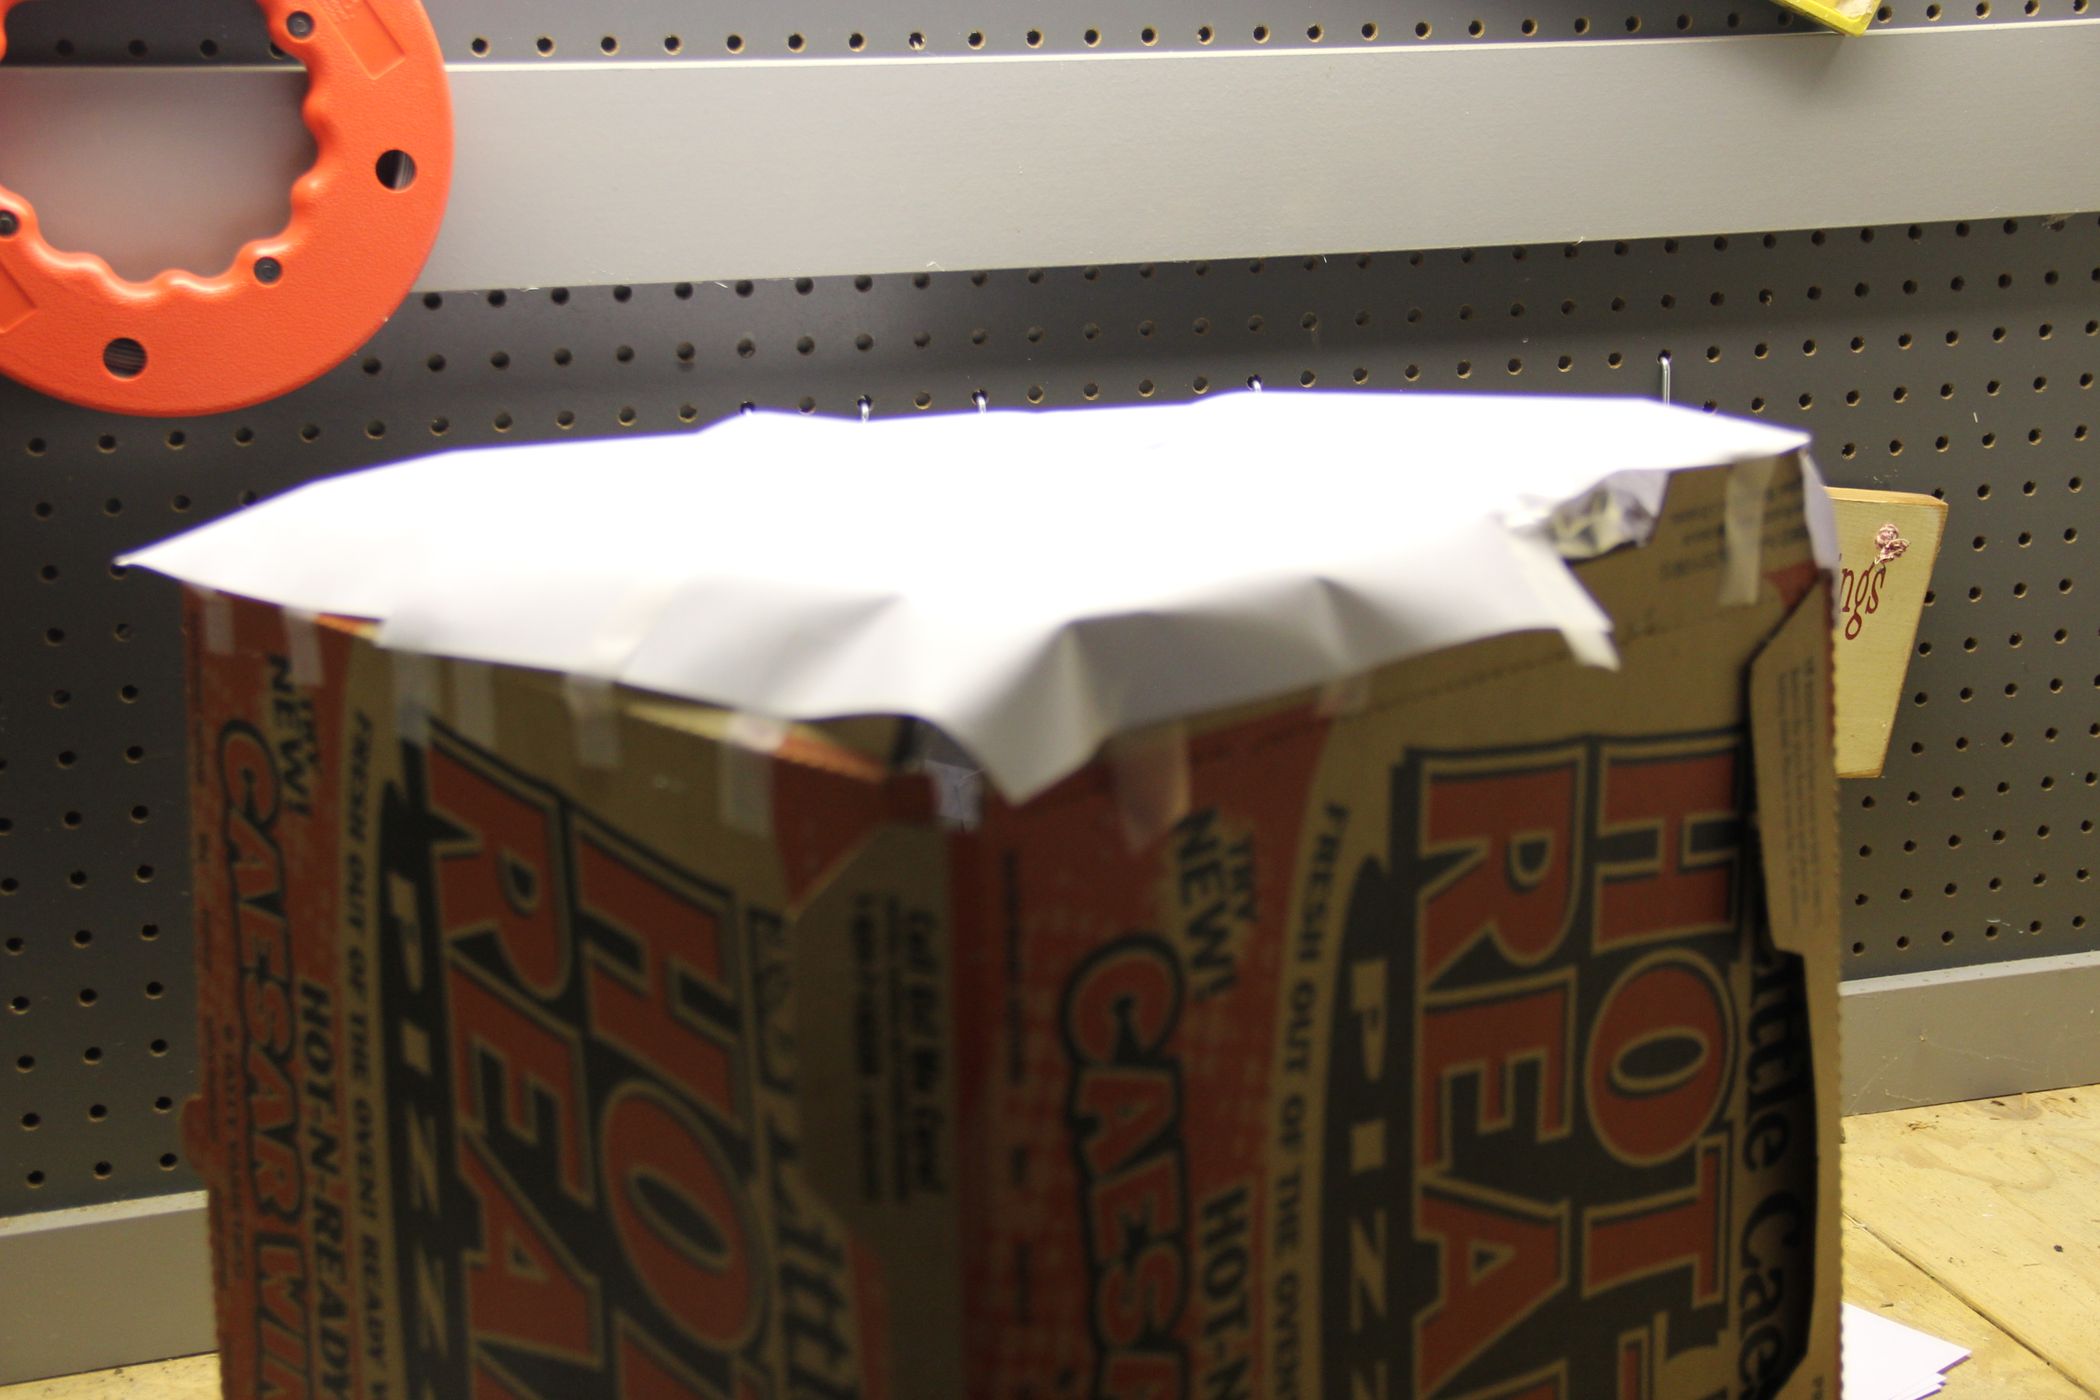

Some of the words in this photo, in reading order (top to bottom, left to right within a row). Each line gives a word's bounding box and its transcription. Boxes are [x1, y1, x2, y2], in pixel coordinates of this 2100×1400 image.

[1839, 553, 1886, 640] ngs
[267, 653, 313, 818] NEW!
[348, 710, 373, 844] FRESH
[346, 852, 368, 931] OUT
[1174, 806, 1240, 1001] NEW!
[1225, 824, 1260, 924] TRY
[1295, 802, 1350, 963] FRESH
[216, 718, 306, 1224] CAESAR
[1285, 980, 1317, 1077] OUT
[350, 1012, 371, 1080] THE
[425, 715, 607, 1400] REA
[1413, 745, 1588, 1400] REA
[352, 1098, 380, 1220] OVEN!
[386, 868, 450, 1400] PIZZ
[1279, 1091, 1307, 1150] OF
[1275, 1172, 1302, 1250] THE
[361, 1233, 388, 1369] READY
[1737, 1192, 1801, 1400] Cae
